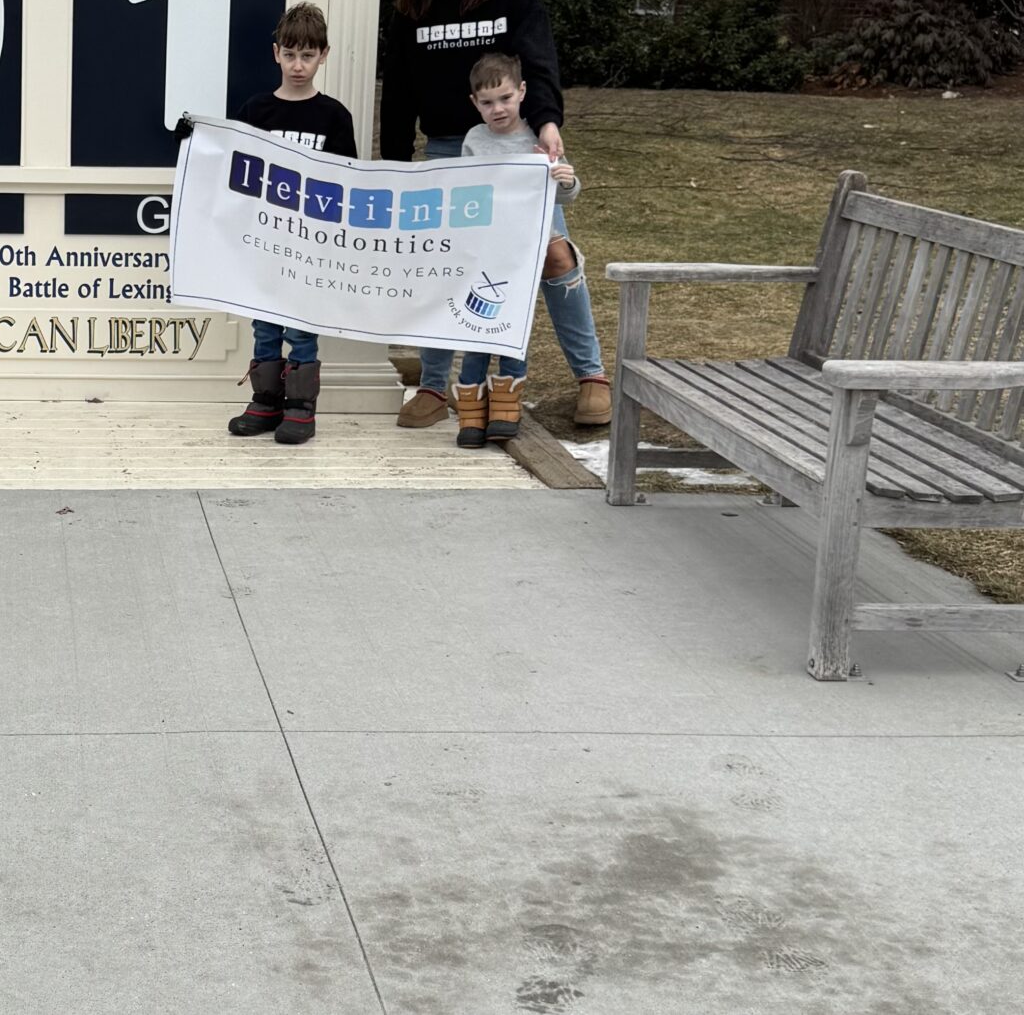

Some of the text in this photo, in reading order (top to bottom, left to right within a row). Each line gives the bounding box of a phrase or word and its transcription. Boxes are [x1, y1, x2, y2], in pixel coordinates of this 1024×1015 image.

[427, 37, 496, 50] orthodontics
[234, 155, 488, 226] levine
[258, 211, 451, 254] orthodontics
[242, 234, 465, 279] CELEBRATING 20 YEARS
[9, 277, 69, 299] Battle
[78, 277, 102, 299] of
[280, 266, 414, 299] IN LEXINGTON
[447, 297, 512, 335] rock your smile
[87, 316, 212, 360] LIBERTY
